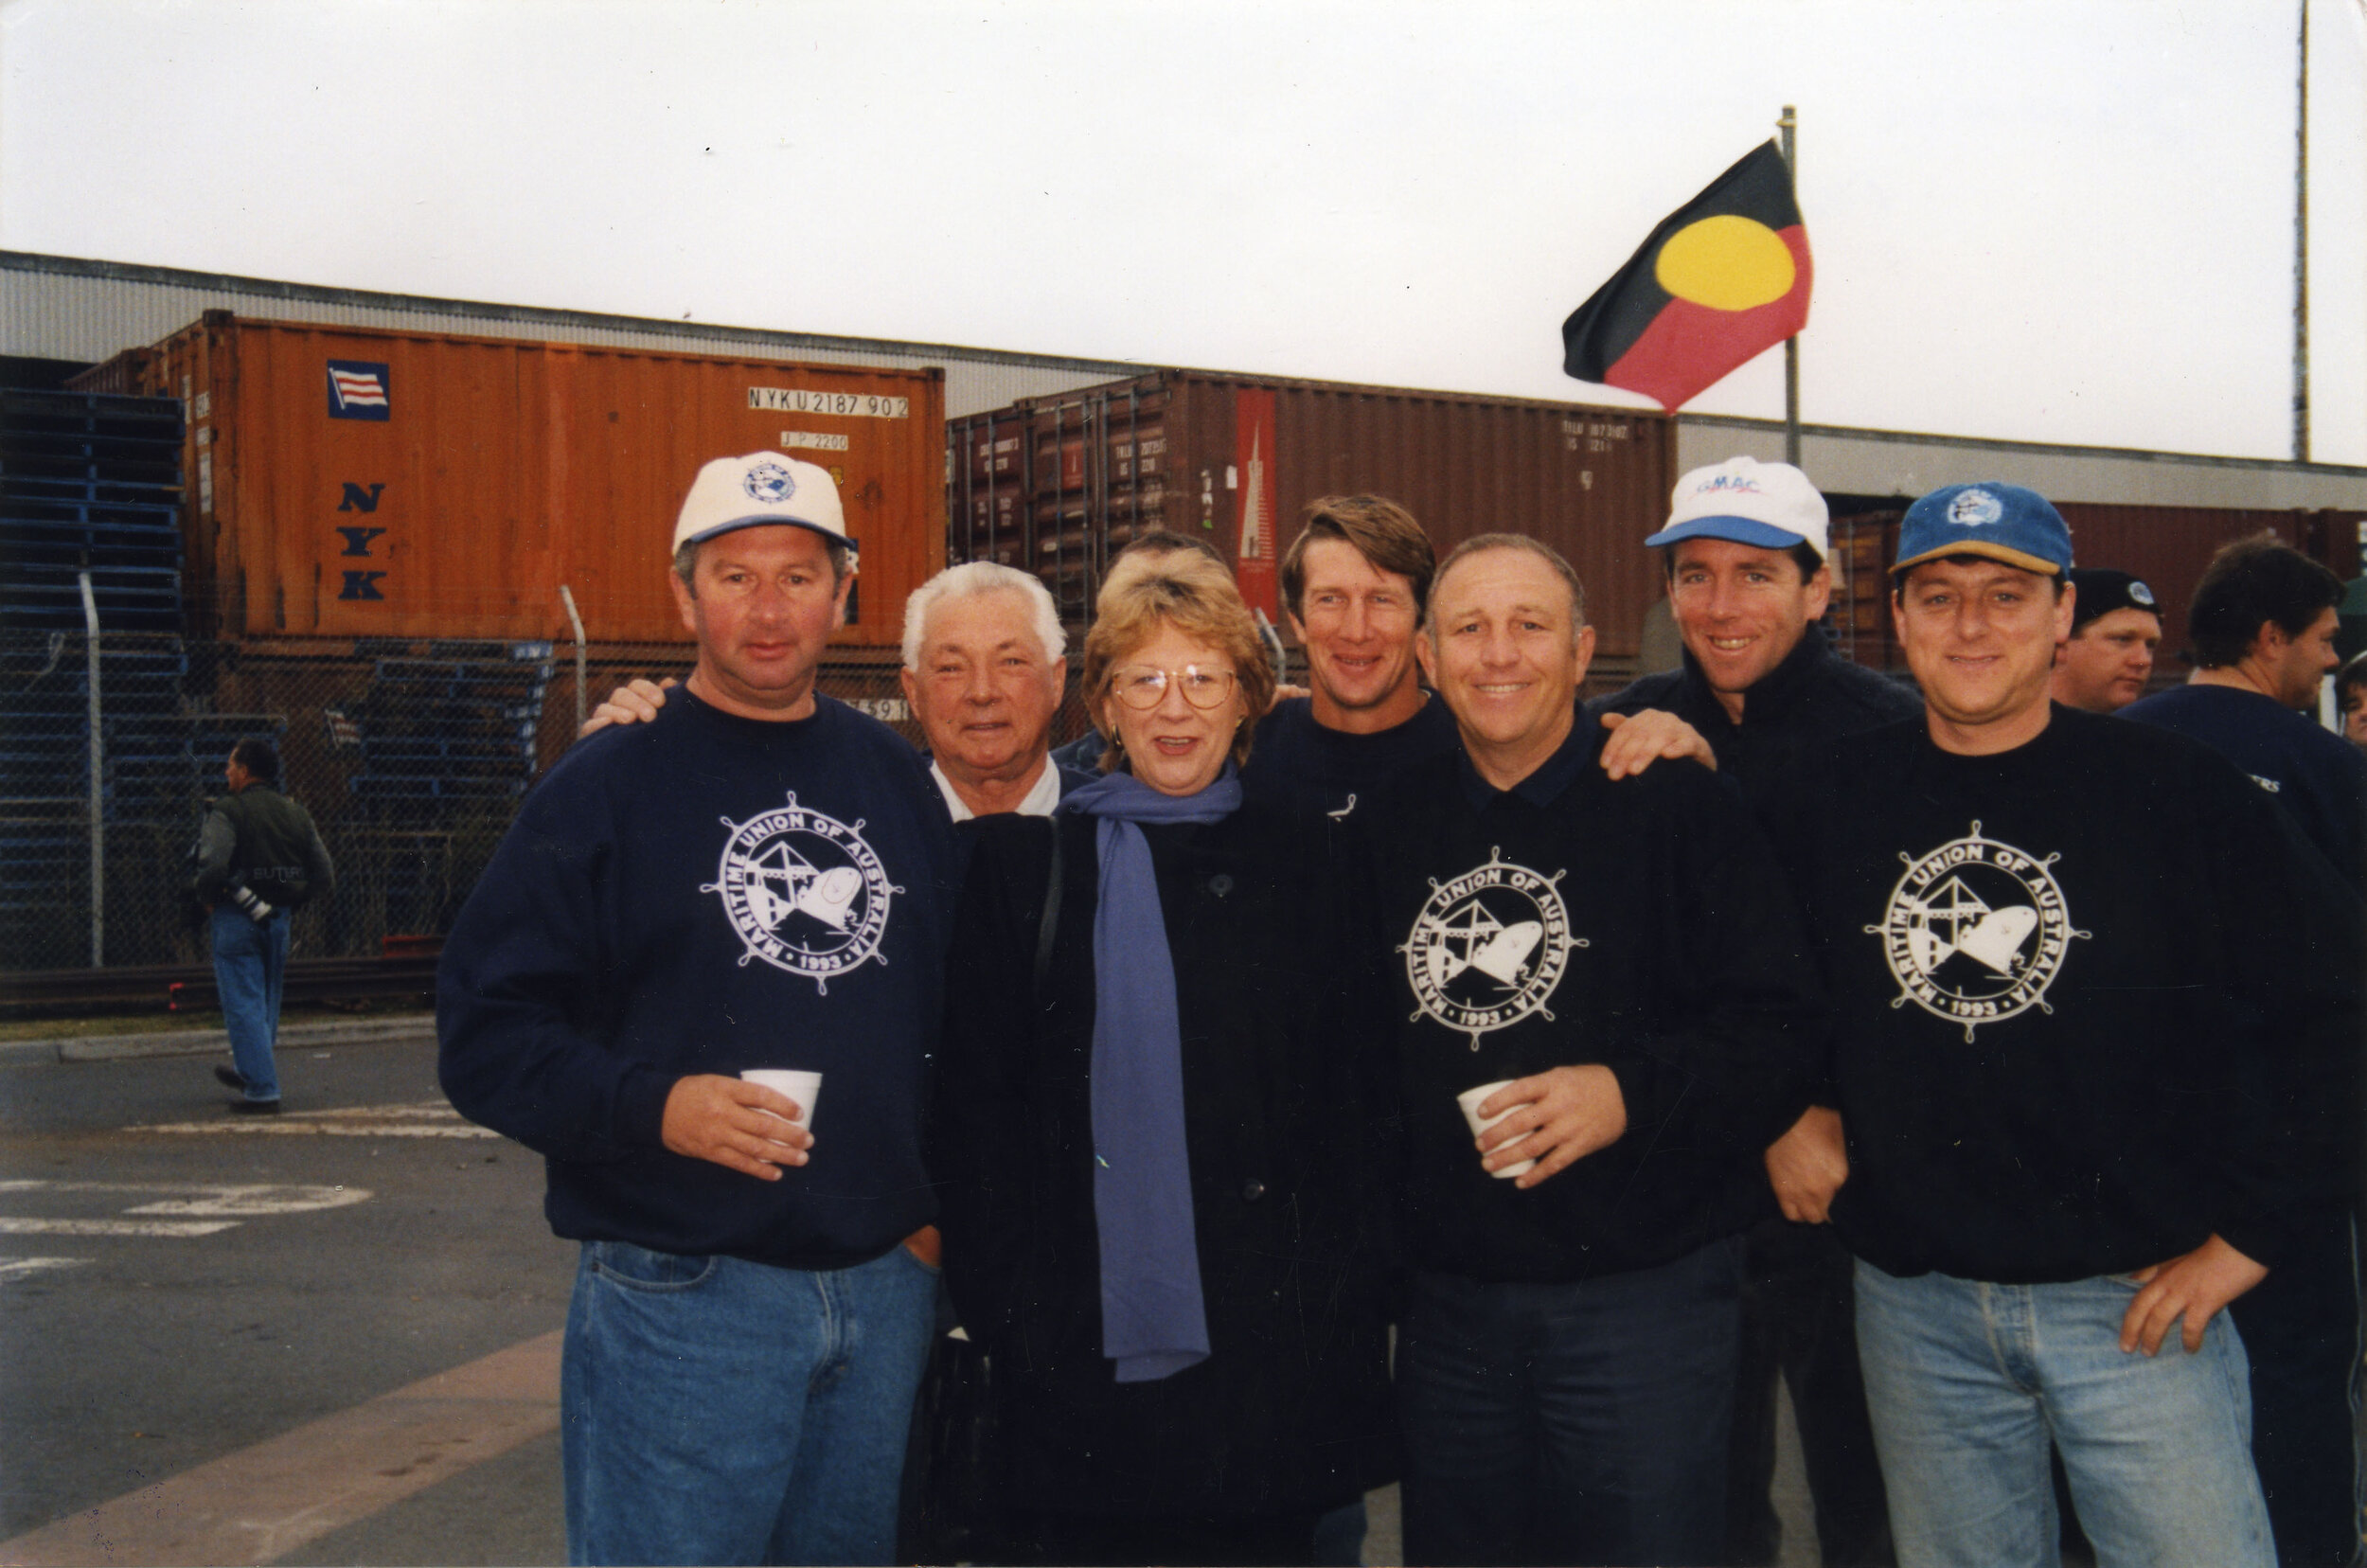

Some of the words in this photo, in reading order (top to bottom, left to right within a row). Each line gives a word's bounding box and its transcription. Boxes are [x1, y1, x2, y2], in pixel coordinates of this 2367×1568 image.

[815, 435, 847, 449] 2200
[739, 812, 805, 848] UNION
[812, 817, 845, 839] OF
[1910, 844, 1984, 886] UNION
[1993, 850, 2031, 873] OF
[845, 841, 885, 957] AUSTRALIA
[1434, 868, 1502, 908] UNION
[1510, 872, 1541, 892] OF
[726, 851, 784, 959] MARITIME
[1512, 893, 1564, 1012] AUSTRALIA
[1890, 891, 1938, 1004] MARITIME
[2009, 877, 2063, 1005] AUSTRALIA
[799, 954, 843, 971] 1993
[1412, 912, 1449, 1016] MARITIME
[1459, 1010, 1502, 1026] 1993
[1950, 1001, 1999, 1017] 1993
